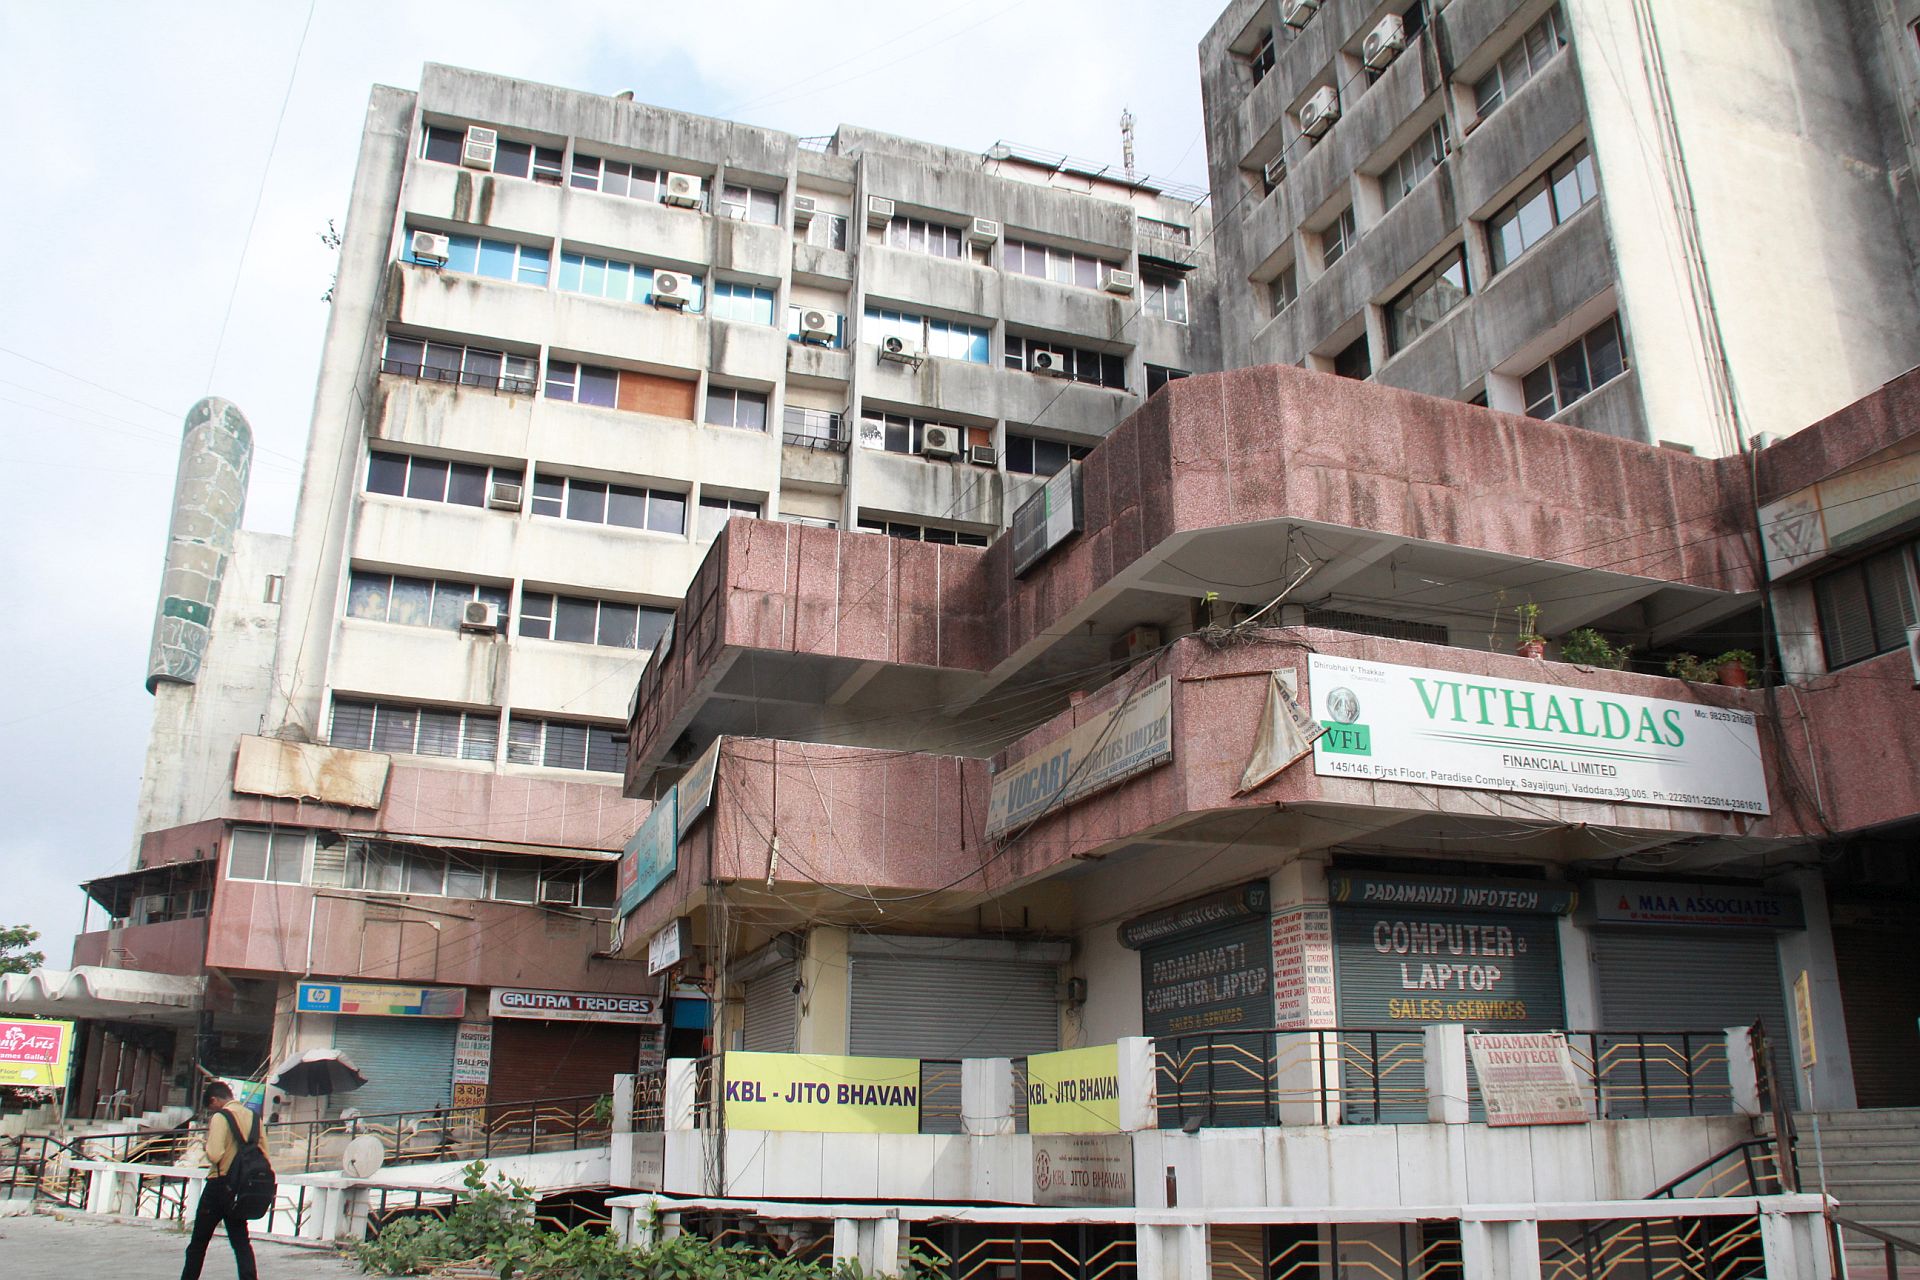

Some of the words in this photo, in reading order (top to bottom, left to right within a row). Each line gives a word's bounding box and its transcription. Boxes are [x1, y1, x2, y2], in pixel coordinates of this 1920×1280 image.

[1313, 660, 1348, 672] Dhirubhai
[1358, 666, 1385, 676] Thakkar
[1409, 677, 1685, 747] VITHALDAS
[1326, 728, 1367, 751] VFL
[1007, 748, 1072, 814] VOCART
[1125, 716, 1167, 754] LIMITED
[1330, 761, 1372, 775] 145/146,
[1374, 766, 1397, 777] First
[1431, 770, 1473, 783] Paradise
[1475, 775, 1519, 788] Complex,
[1503, 754, 1568, 772] FINANCIAL
[1571, 762, 1617, 777] LIMITED
[1250, 890, 1265, 906] 67
[1363, 883, 1457, 904] PADAMAVATI
[1463, 887, 1538, 909] INFOTECH
[1639, 895, 1680, 912] MAA
[1686, 898, 1782, 915] ASSOCIATES
[1373, 920, 1515, 957] COMPUTER
[1517, 937, 1527, 953] &
[1153, 942, 1246, 983] PADAMAVATI
[1400, 962, 1501, 991] LAPTOP
[313, 989, 326, 1001] hp
[1146, 978, 1209, 1013] COMPUTER
[1213, 967, 1267, 1000] LAPTOP
[502, 992, 570, 1008] GAUTAM
[576, 997, 650, 1013] TRADERS
[1388, 999, 1444, 1020] SALES
[1203, 1007, 1244, 1027] SERVICES
[18, 1036, 54, 1050] Arts
[1472, 1034, 1565, 1050] PADAMAVATI
[1487, 1050, 1558, 1064] INFOTECH
[726, 1080, 766, 1103] KBL
[785, 1081, 831, 1104] JITO
[837, 1083, 917, 1107] BHAVAN
[1029, 1087, 1047, 1105] KBL
[1055, 1078, 1077, 1104] JITO
[1079, 1075, 1119, 1101] BHAVAN
[1052, 1169, 1067, 1186] KBL
[1070, 1170, 1089, 1187] JITO
[1092, 1171, 1127, 1189] BHAVAN
